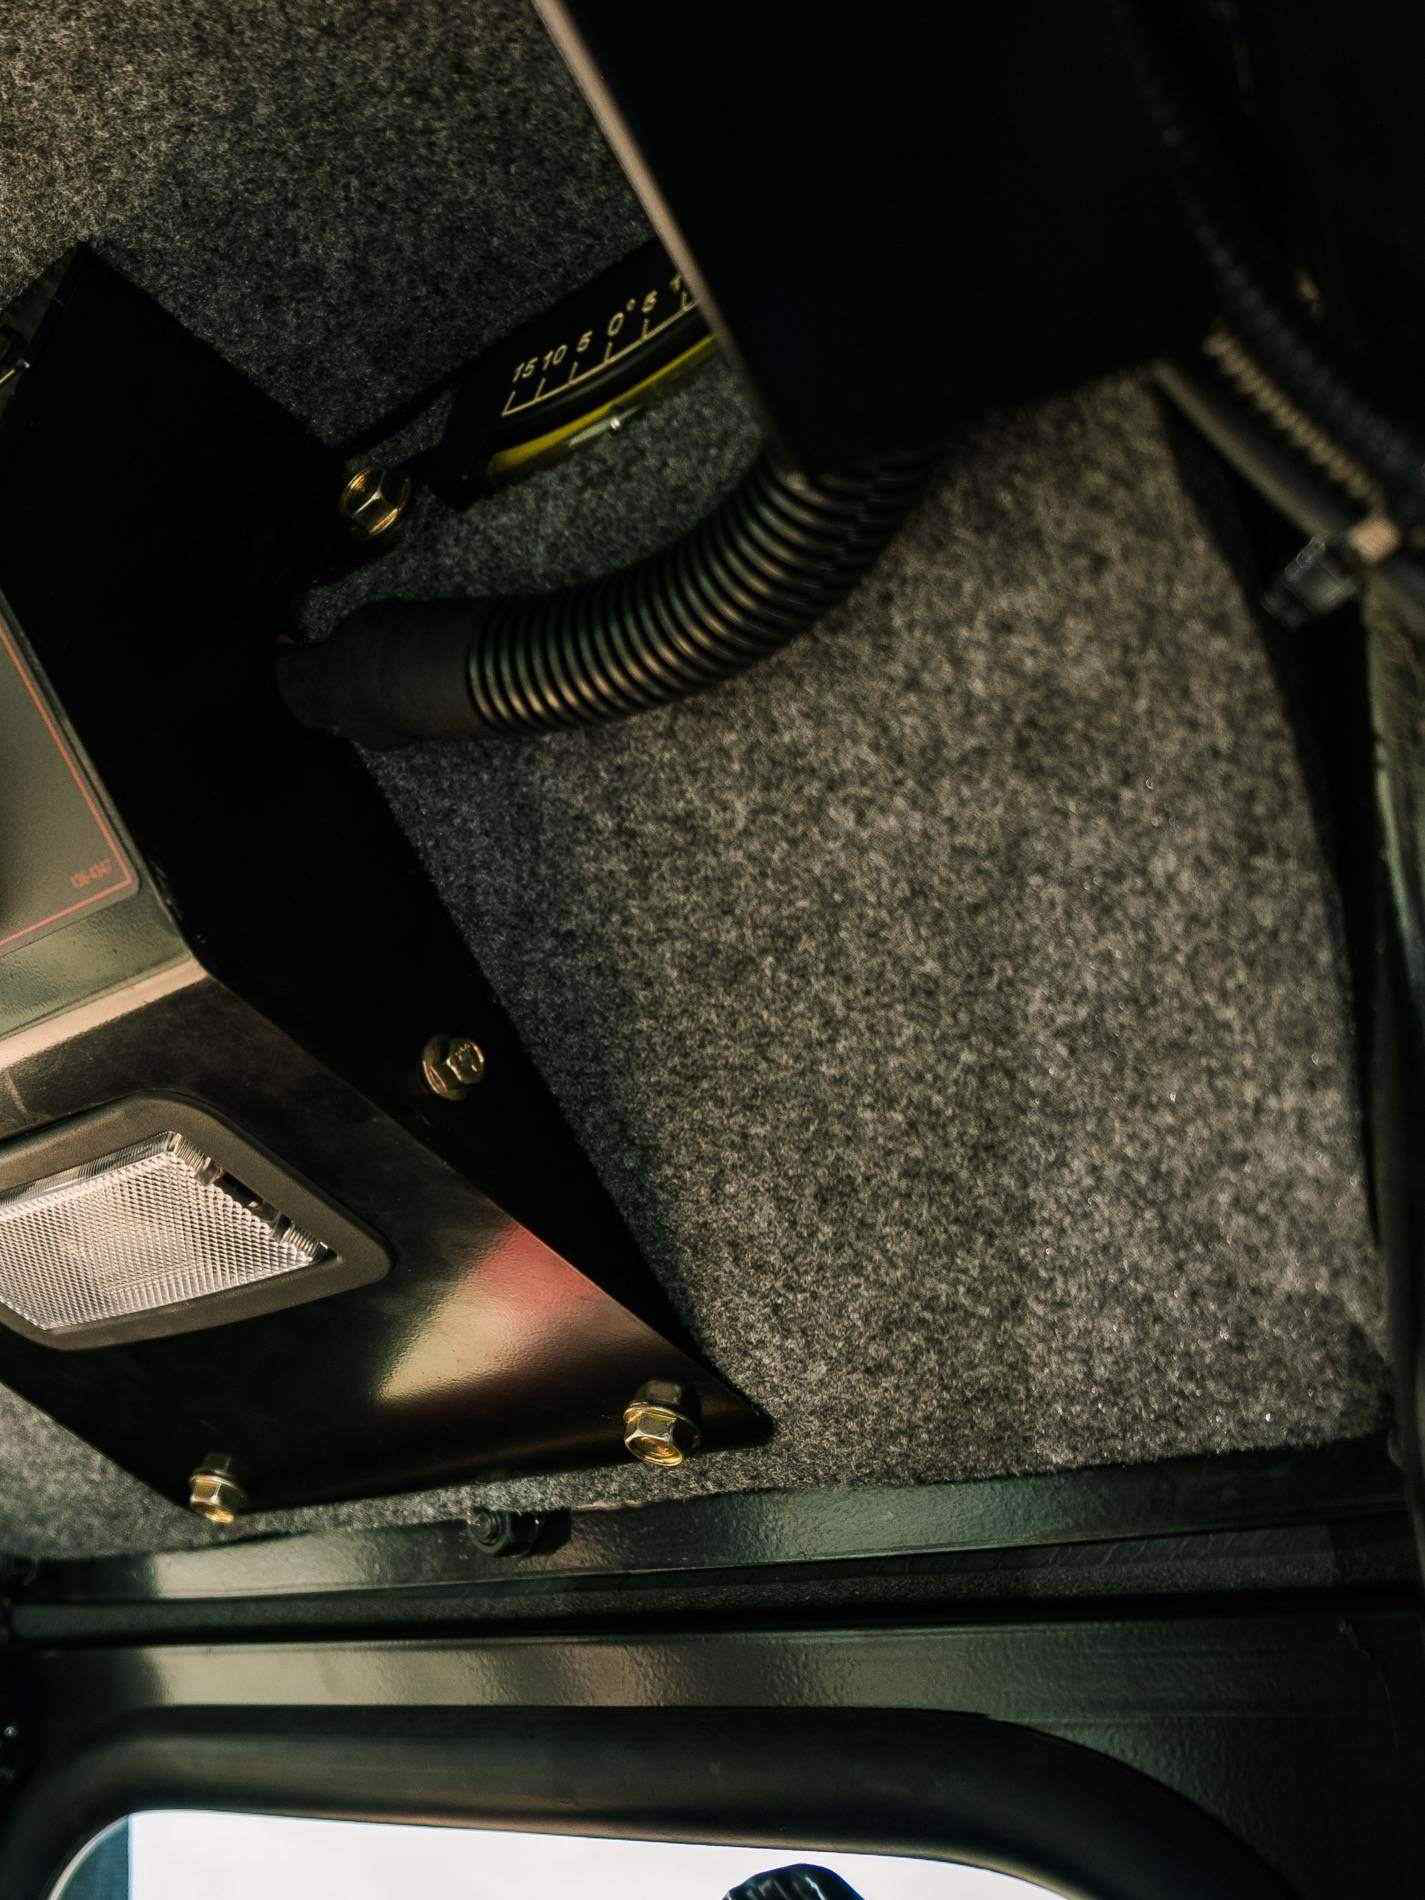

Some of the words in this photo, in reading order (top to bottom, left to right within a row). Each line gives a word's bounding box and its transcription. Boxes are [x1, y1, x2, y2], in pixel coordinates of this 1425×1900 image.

[513, 357, 538, 382] 15
[543, 345, 567, 371] 10
[577, 331, 593, 352] 5
